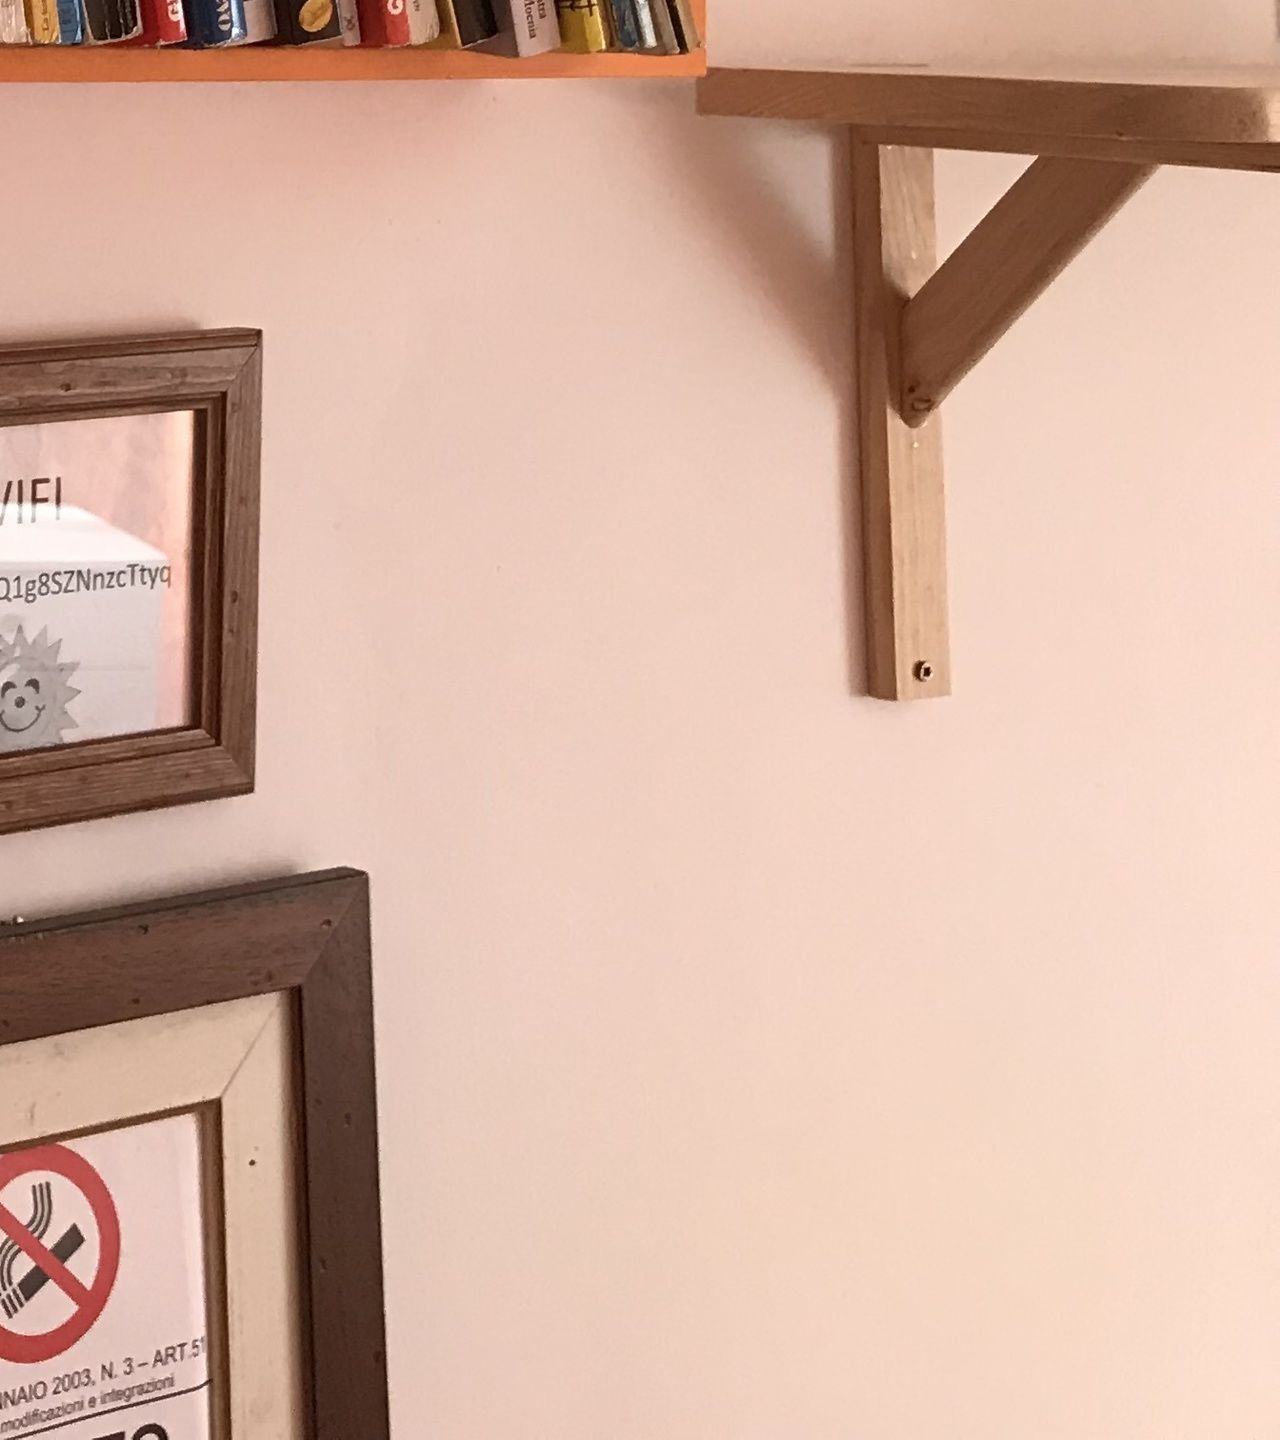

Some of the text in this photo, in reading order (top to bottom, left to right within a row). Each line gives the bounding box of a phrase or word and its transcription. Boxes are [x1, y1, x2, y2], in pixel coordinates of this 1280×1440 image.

[51, 1367, 97, 1396] 2003,
[100, 1360, 119, 1382] N.
[122, 1357, 135, 1377] 3
[87, 1395, 98, 1410] e
[99, 1371, 176, 1406] integrazioni
